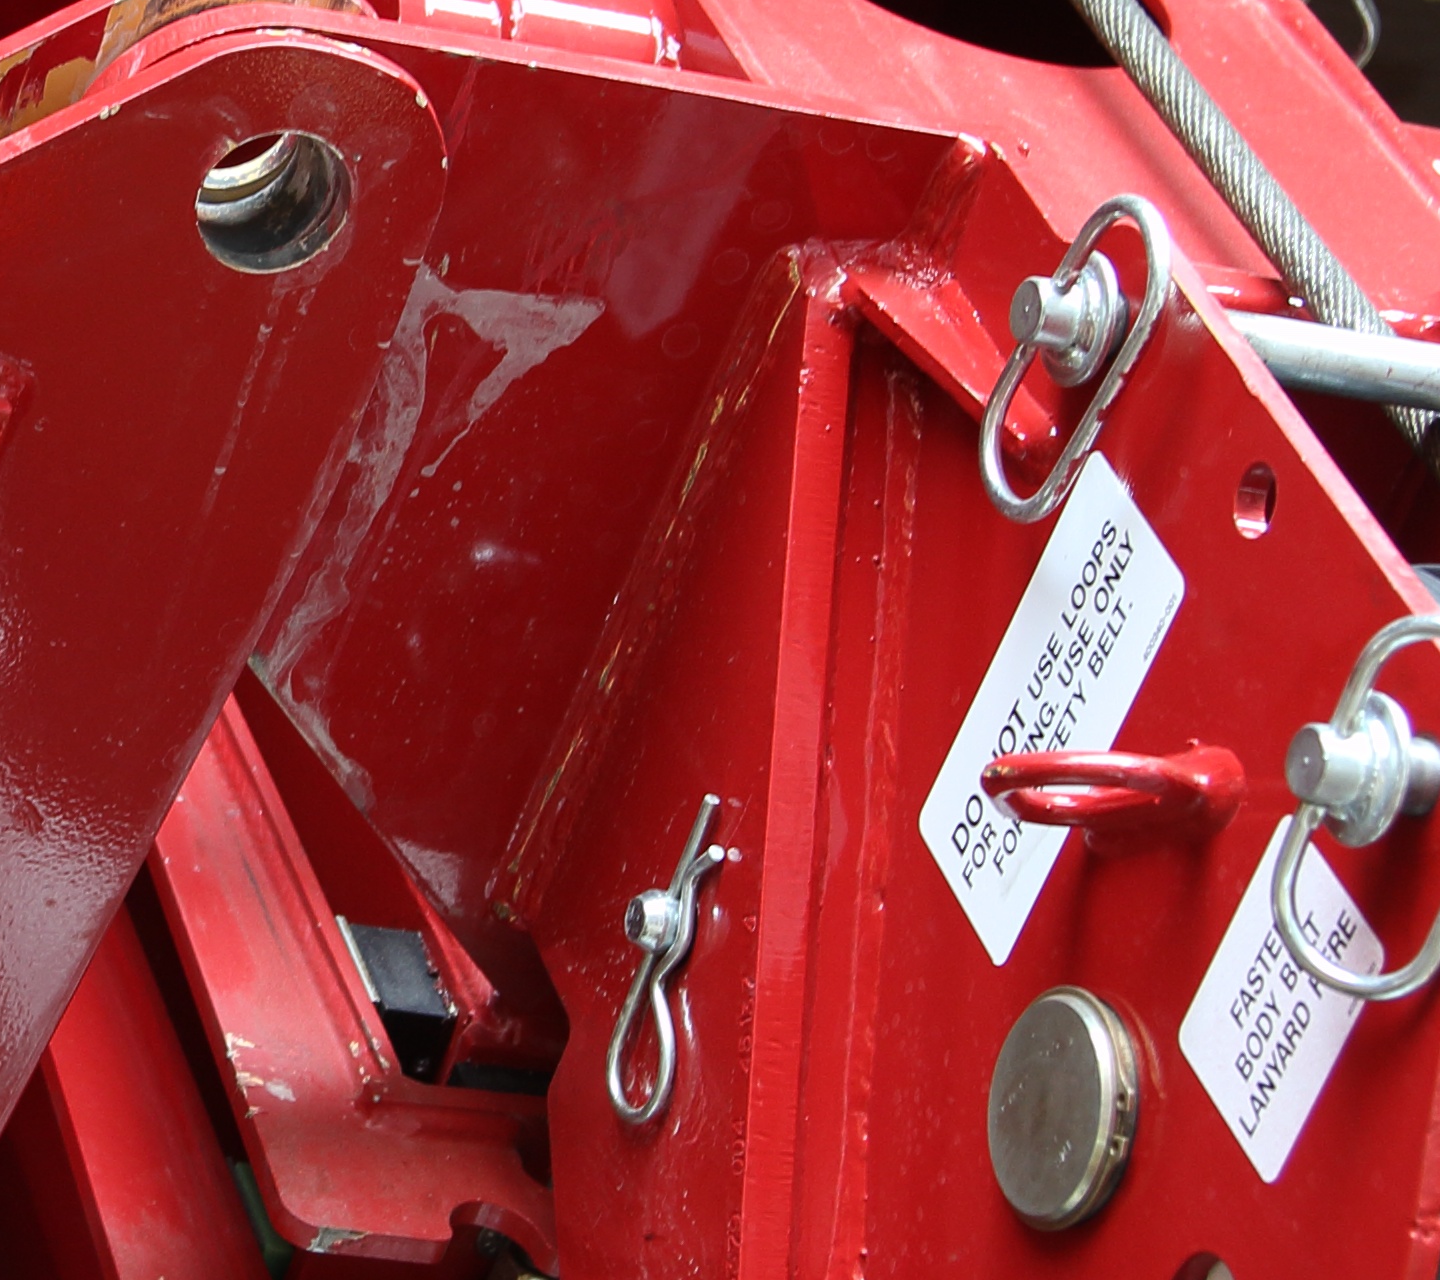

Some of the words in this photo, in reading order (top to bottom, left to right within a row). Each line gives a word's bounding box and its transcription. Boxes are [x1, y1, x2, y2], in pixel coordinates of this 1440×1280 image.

[951, 794, 983, 857] DO
[1027, 631, 1064, 700] USE
[1061, 520, 1118, 631] LOOPS
[962, 823, 997, 888] FOR
[1058, 619, 1094, 688] USE
[1094, 529, 1134, 614] ONLY
[1088, 597, 1134, 678] BELT.
[1230, 925, 1282, 1029] FASTE
[1235, 990, 1281, 1082] BODY
[1280, 911, 1321, 992] BT
[1239, 1001, 1311, 1138] LANYARD
